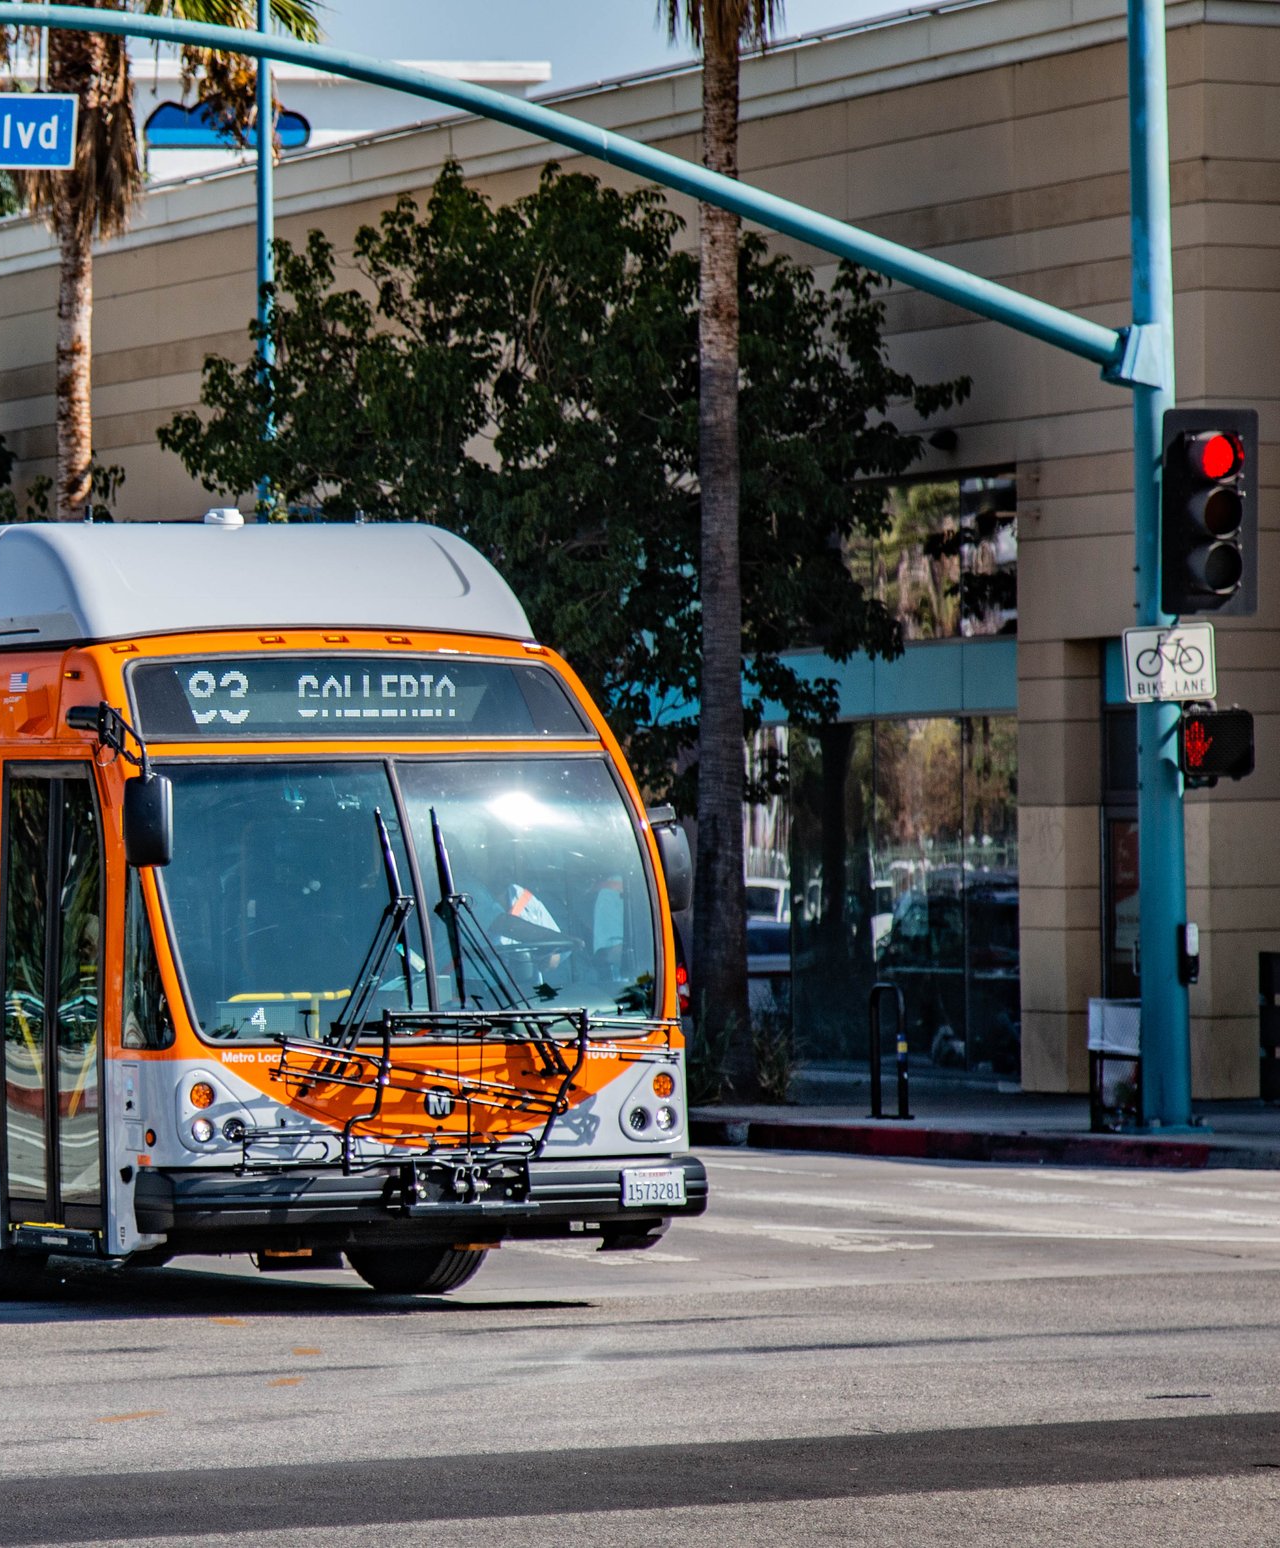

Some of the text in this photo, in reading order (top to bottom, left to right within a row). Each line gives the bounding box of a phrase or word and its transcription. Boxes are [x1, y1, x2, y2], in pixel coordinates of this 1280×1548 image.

[1137, 679, 1205, 695] BIKE LANE
[251, 1007, 267, 1032] 4
[221, 1052, 287, 1063] Metro Loca
[428, 1090, 452, 1115] M
[628, 1182, 682, 1201] 1573281
